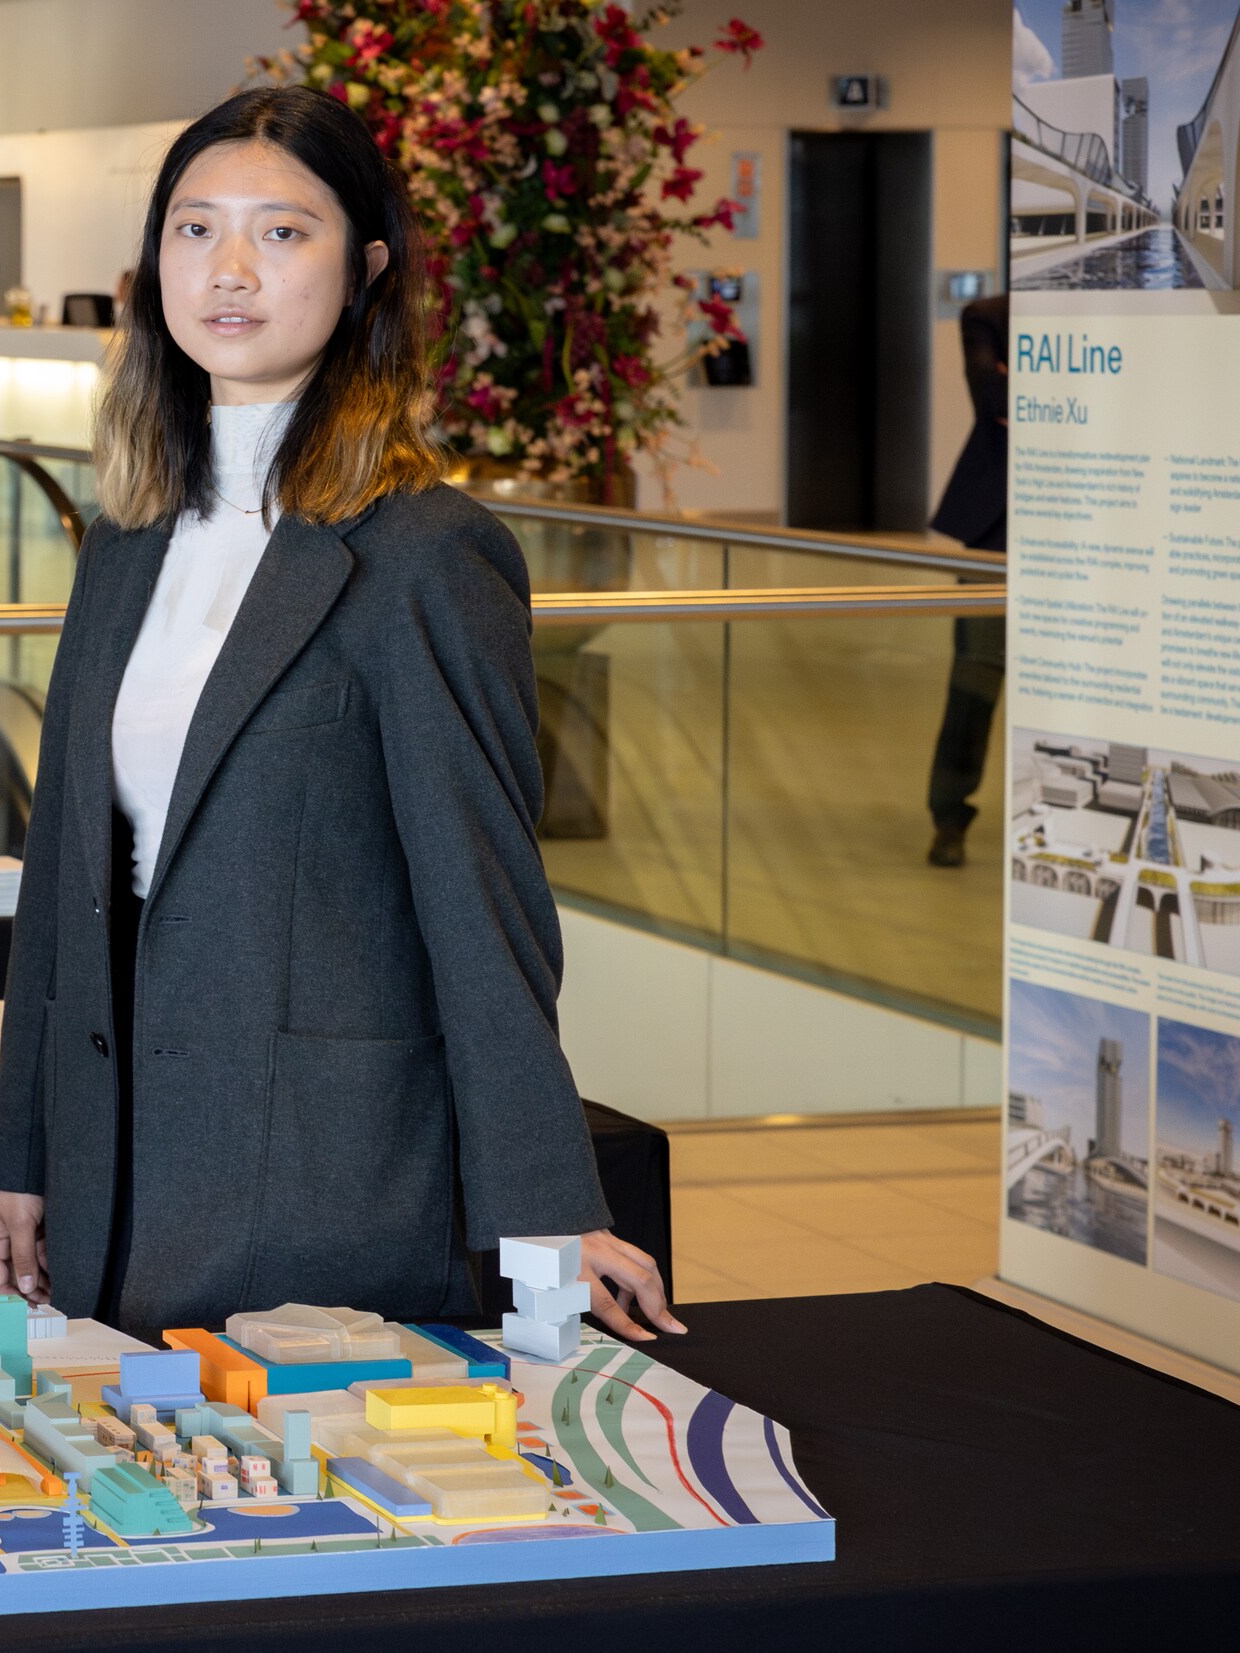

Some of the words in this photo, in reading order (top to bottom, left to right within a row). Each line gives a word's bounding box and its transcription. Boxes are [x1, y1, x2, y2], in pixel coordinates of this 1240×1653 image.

[1017, 333, 1061, 373] RAI
[1067, 333, 1123, 375] Line
[1016, 395, 1063, 424] Ethnie
[1065, 396, 1088, 425] Xu
